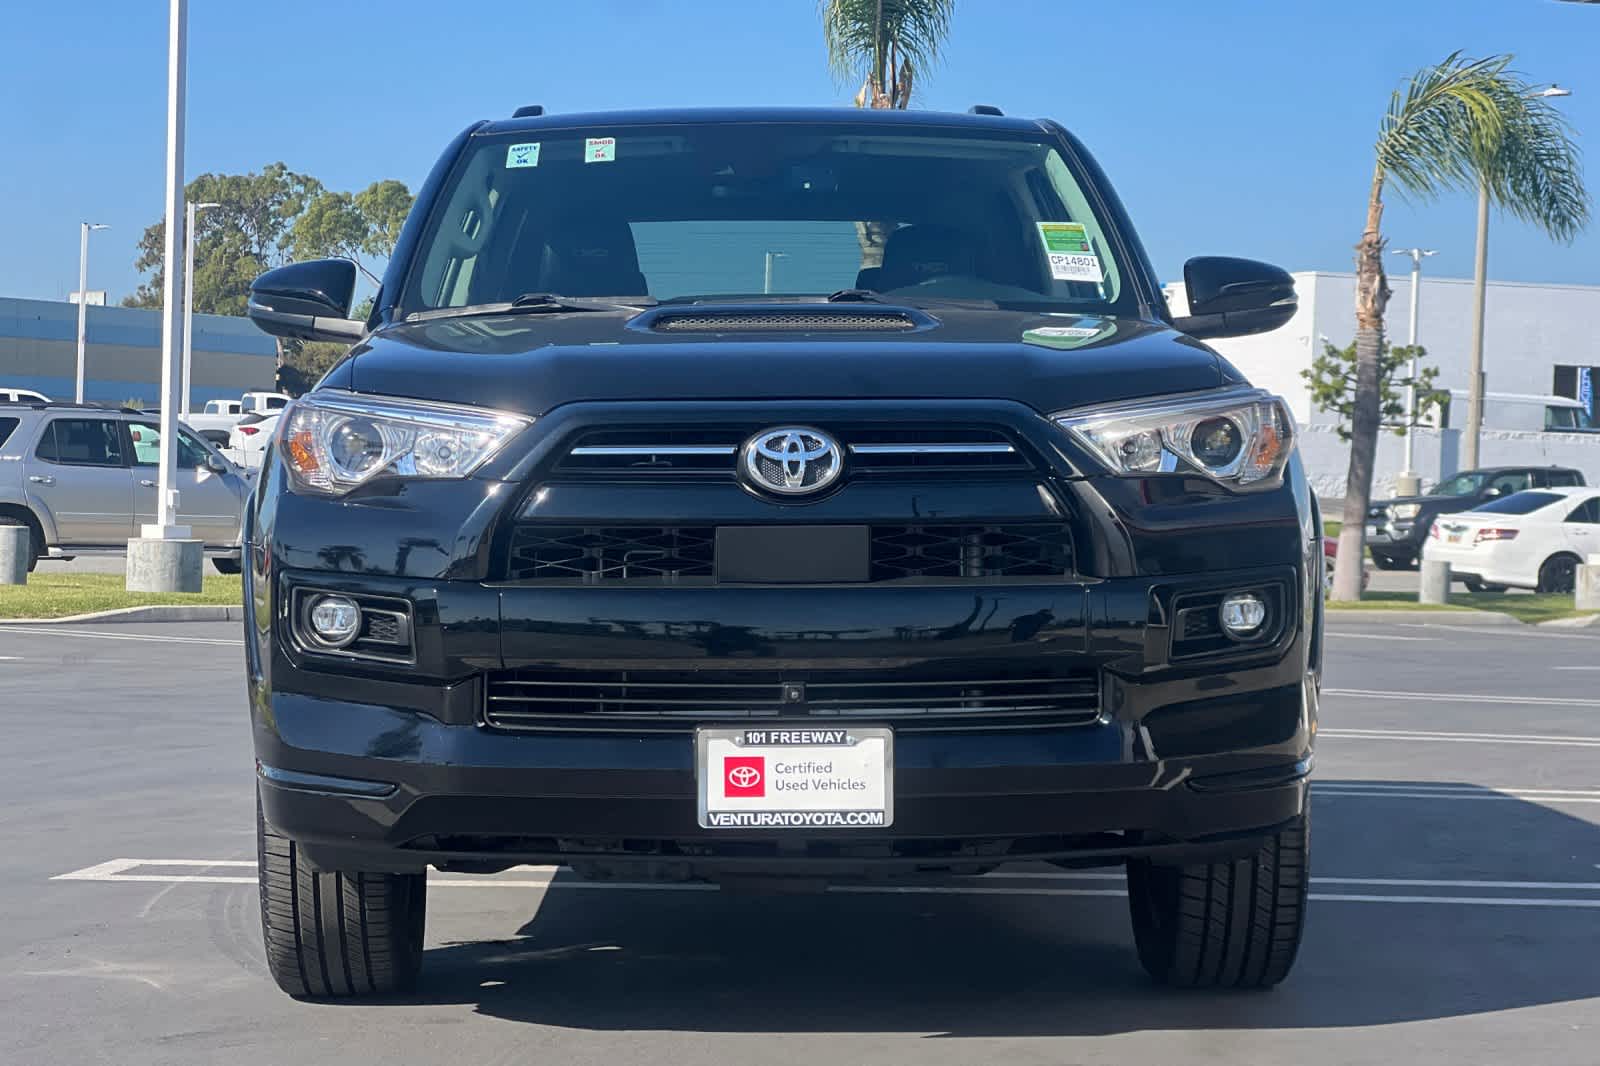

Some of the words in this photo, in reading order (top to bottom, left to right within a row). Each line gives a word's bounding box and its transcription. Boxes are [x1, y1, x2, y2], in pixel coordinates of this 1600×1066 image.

[594, 152, 606, 160] OK
[1050, 255, 1097, 267] CP14801
[746, 732, 767, 744] 101
[770, 731, 845, 744] FREEWAY
[775, 762, 833, 775] Certified
[775, 779, 809, 791] Used
[811, 778, 867, 791] Vehicles
[709, 812, 884, 826] VENTURATOYOTA.COM
